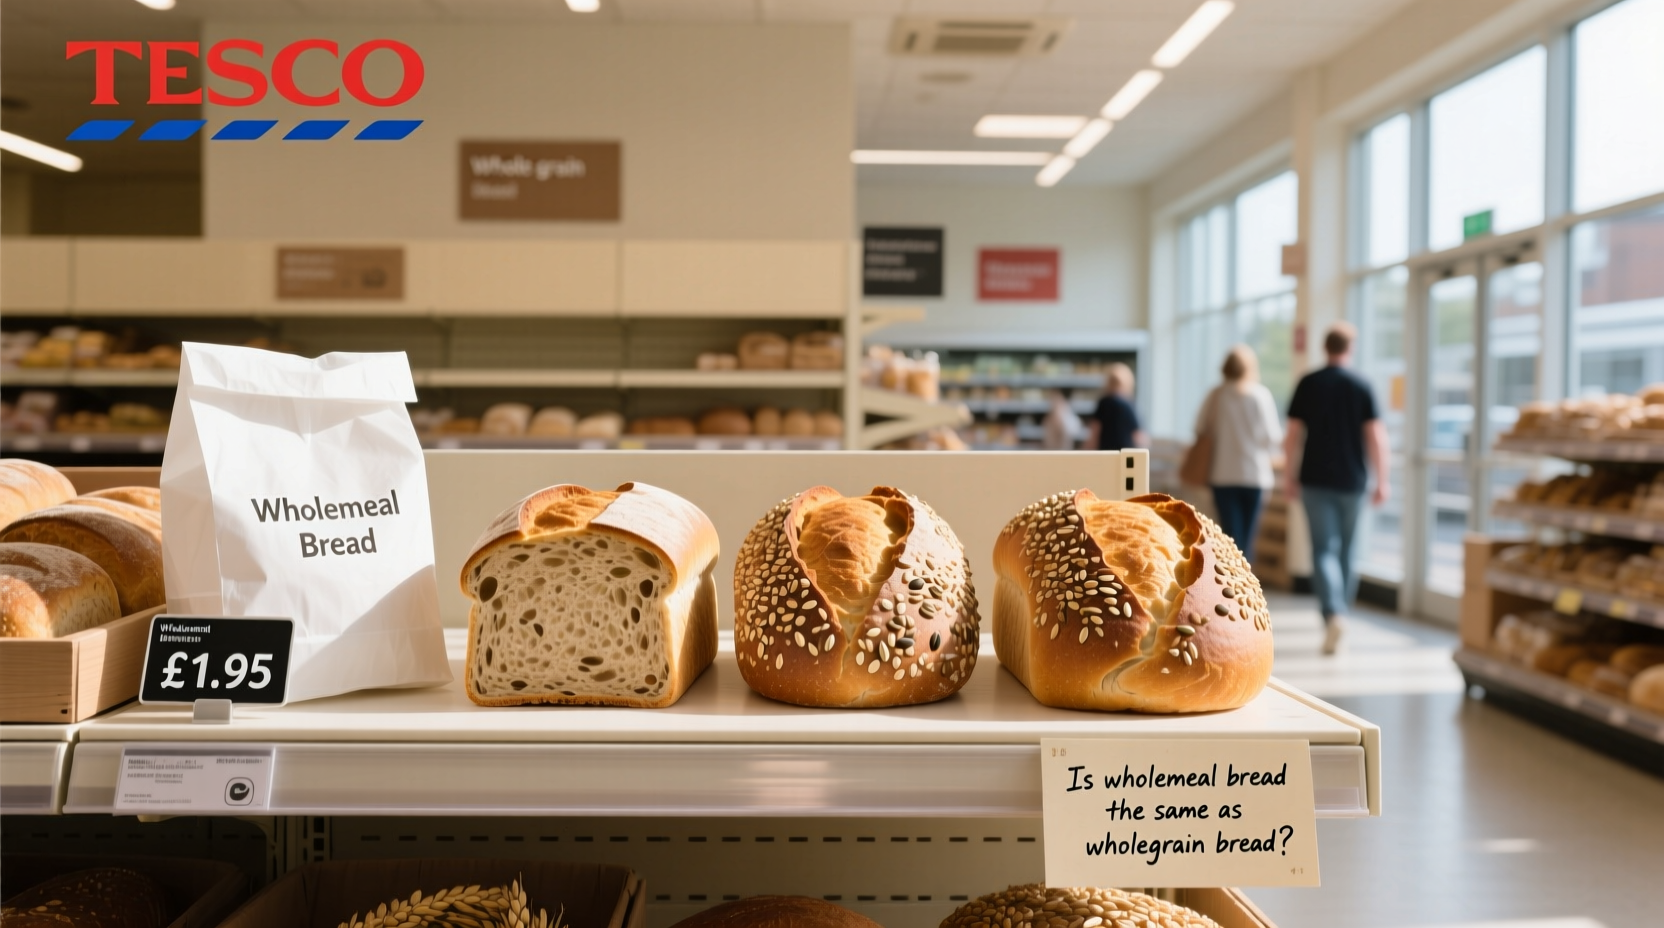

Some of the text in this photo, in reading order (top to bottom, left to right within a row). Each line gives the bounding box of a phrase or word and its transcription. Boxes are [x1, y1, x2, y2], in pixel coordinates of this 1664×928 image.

[251, 489, 400, 523] Wholemeal
[299, 527, 377, 558] Bread
[160, 651, 273, 690] £1.95
[1066, 763, 1287, 792] Is wholemeal bread
[1105, 798, 1242, 821] the same as
[1086, 825, 1294, 866] wholegrain bread?
